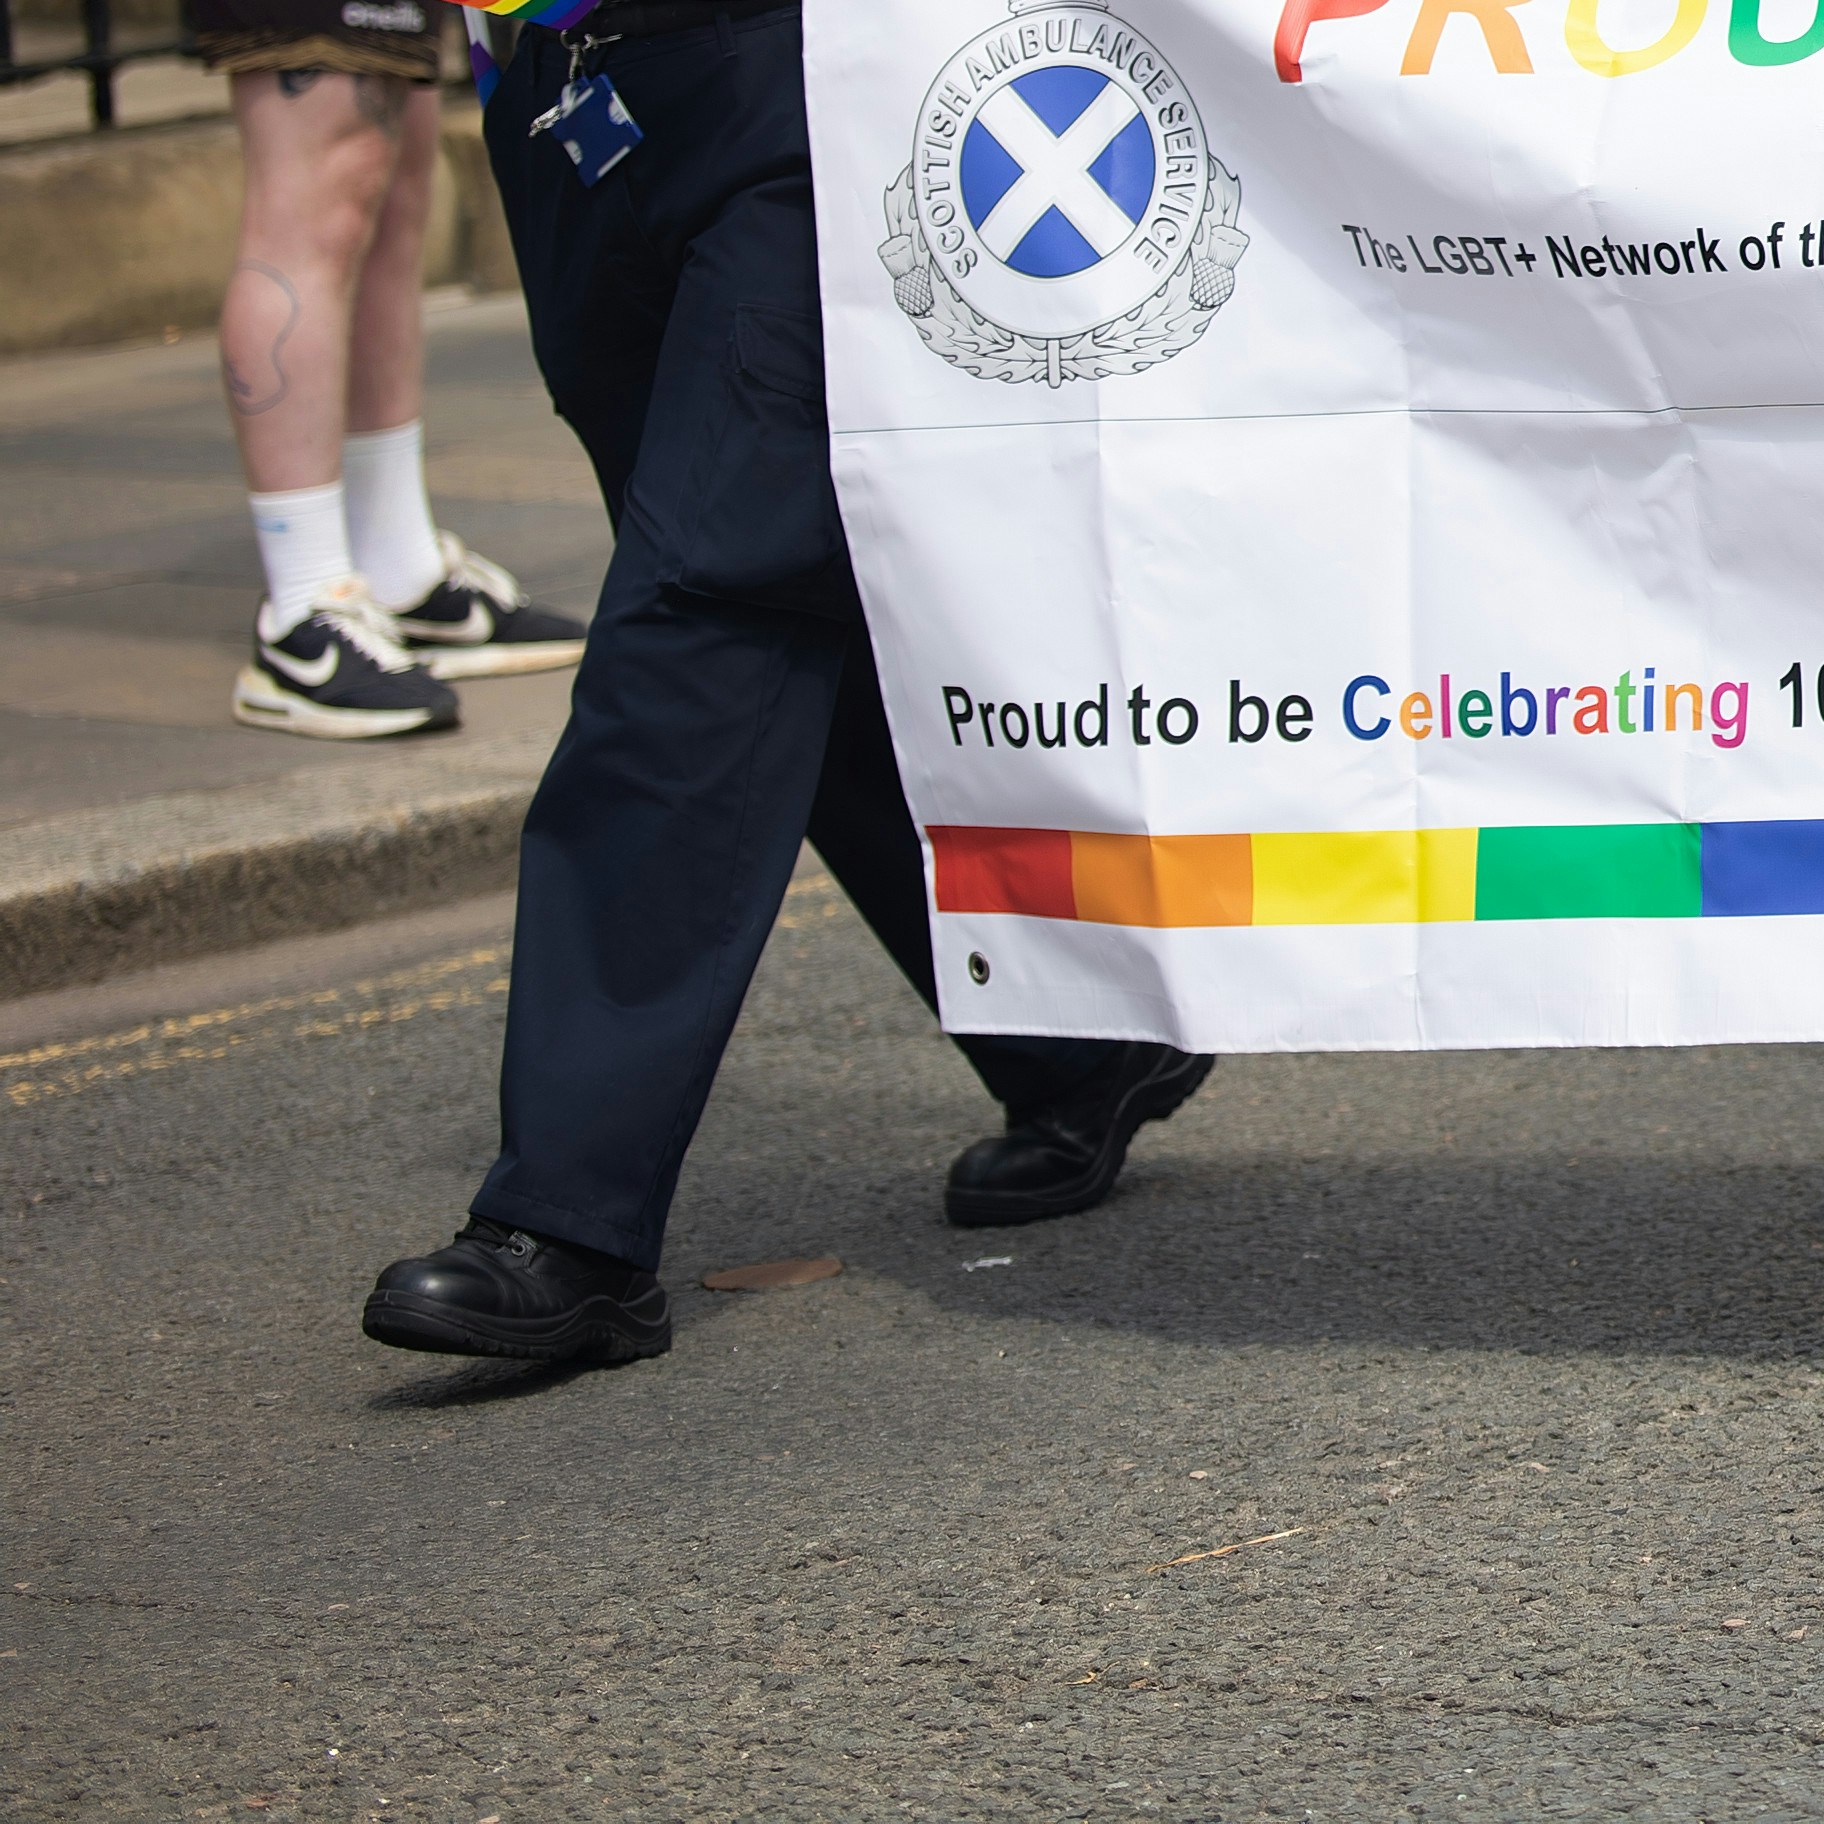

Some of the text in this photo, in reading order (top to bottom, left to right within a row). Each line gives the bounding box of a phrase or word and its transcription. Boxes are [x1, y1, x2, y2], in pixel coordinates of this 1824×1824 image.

[921, 18, 1198, 280] SCOTTISH AMBULANCE SERVICE
[1341, 224, 1408, 274] The
[1406, 234, 1538, 278] LGBT+
[1545, 228, 1728, 279] Network
[1740, 222, 1786, 272] of
[943, 684, 1109, 750] Proud
[1128, 686, 1200, 746] to
[1230, 680, 1314, 744] be
[1343, 667, 1750, 750] Celebrating
